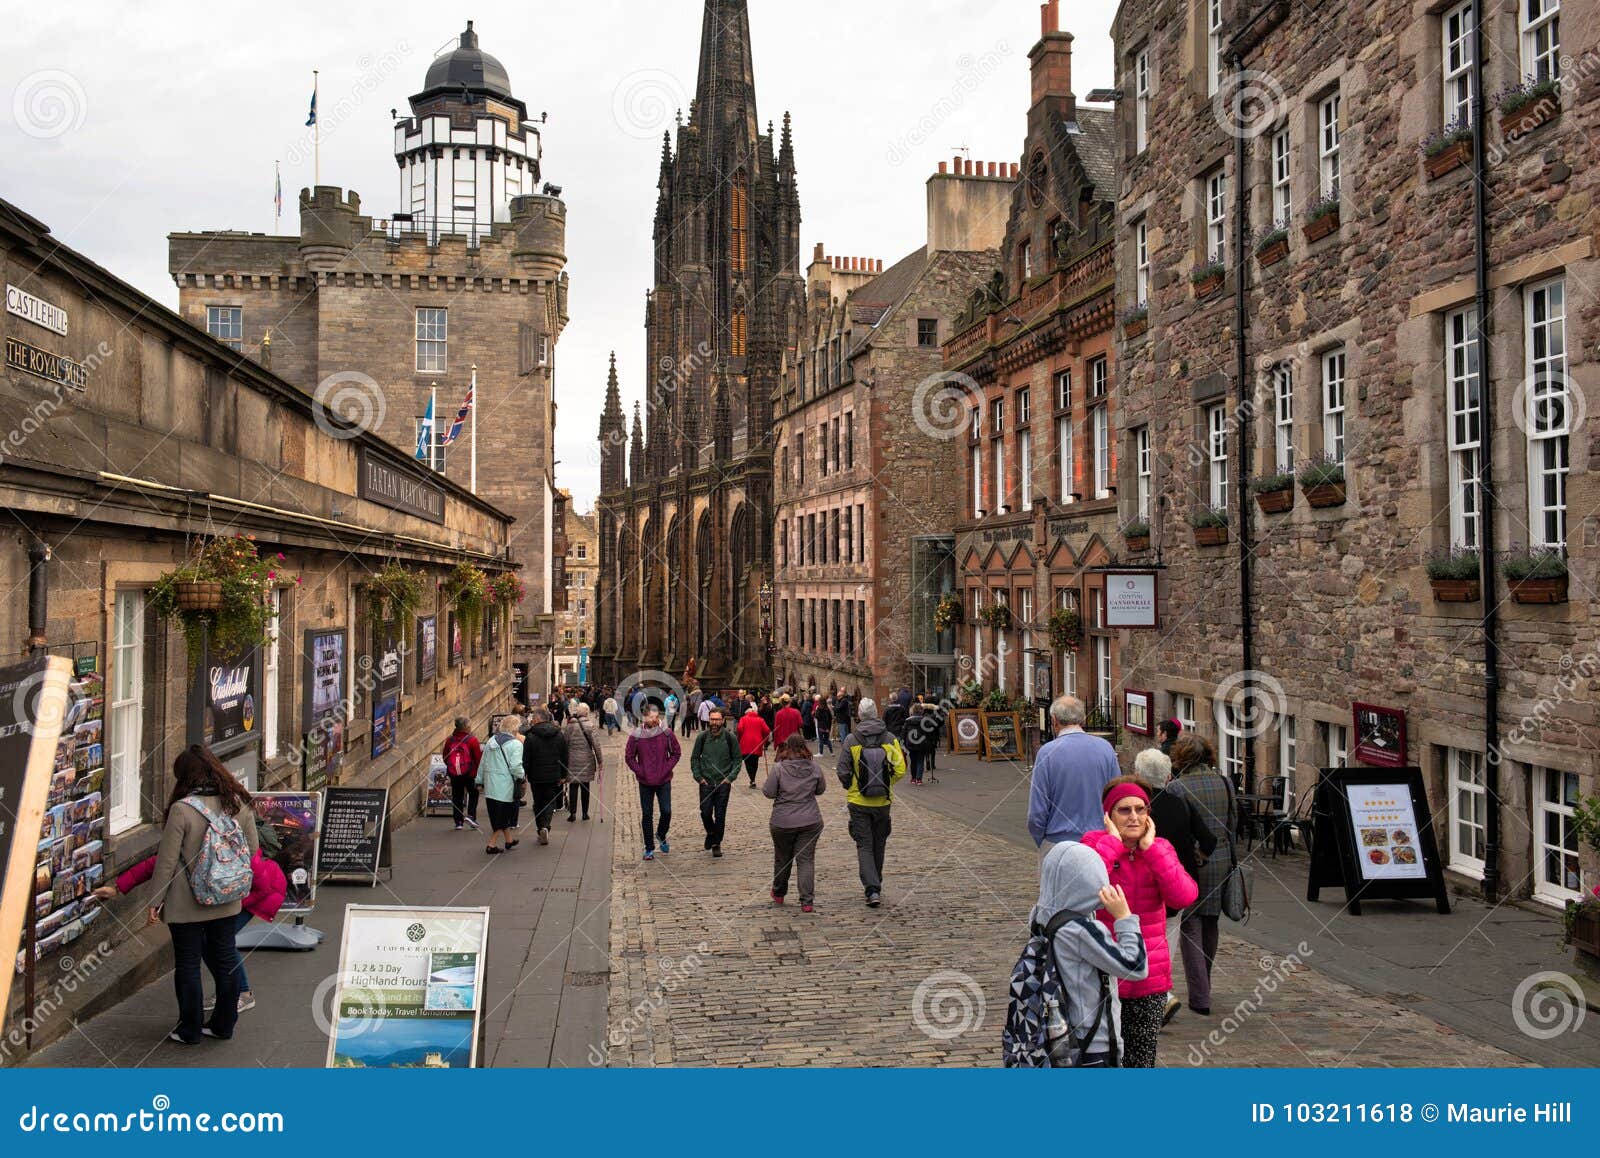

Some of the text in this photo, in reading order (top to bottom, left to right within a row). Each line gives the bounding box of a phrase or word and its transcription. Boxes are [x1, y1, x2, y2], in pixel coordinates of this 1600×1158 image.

[8, 289, 66, 332] CASTLEHILL
[7, 341, 87, 388] THE ROYAL MILE
[367, 462, 440, 516] TARTAN WEAVING MILL
[210, 666, 250, 705] Castlehill
[351, 975, 427, 988] Highland Tours
[353, 963, 402, 974] 1, 2 & 3 Day
[347, 1007, 367, 1015] Book
[369, 1007, 393, 1017] Today,
[395, 1008, 417, 1016] Travel
